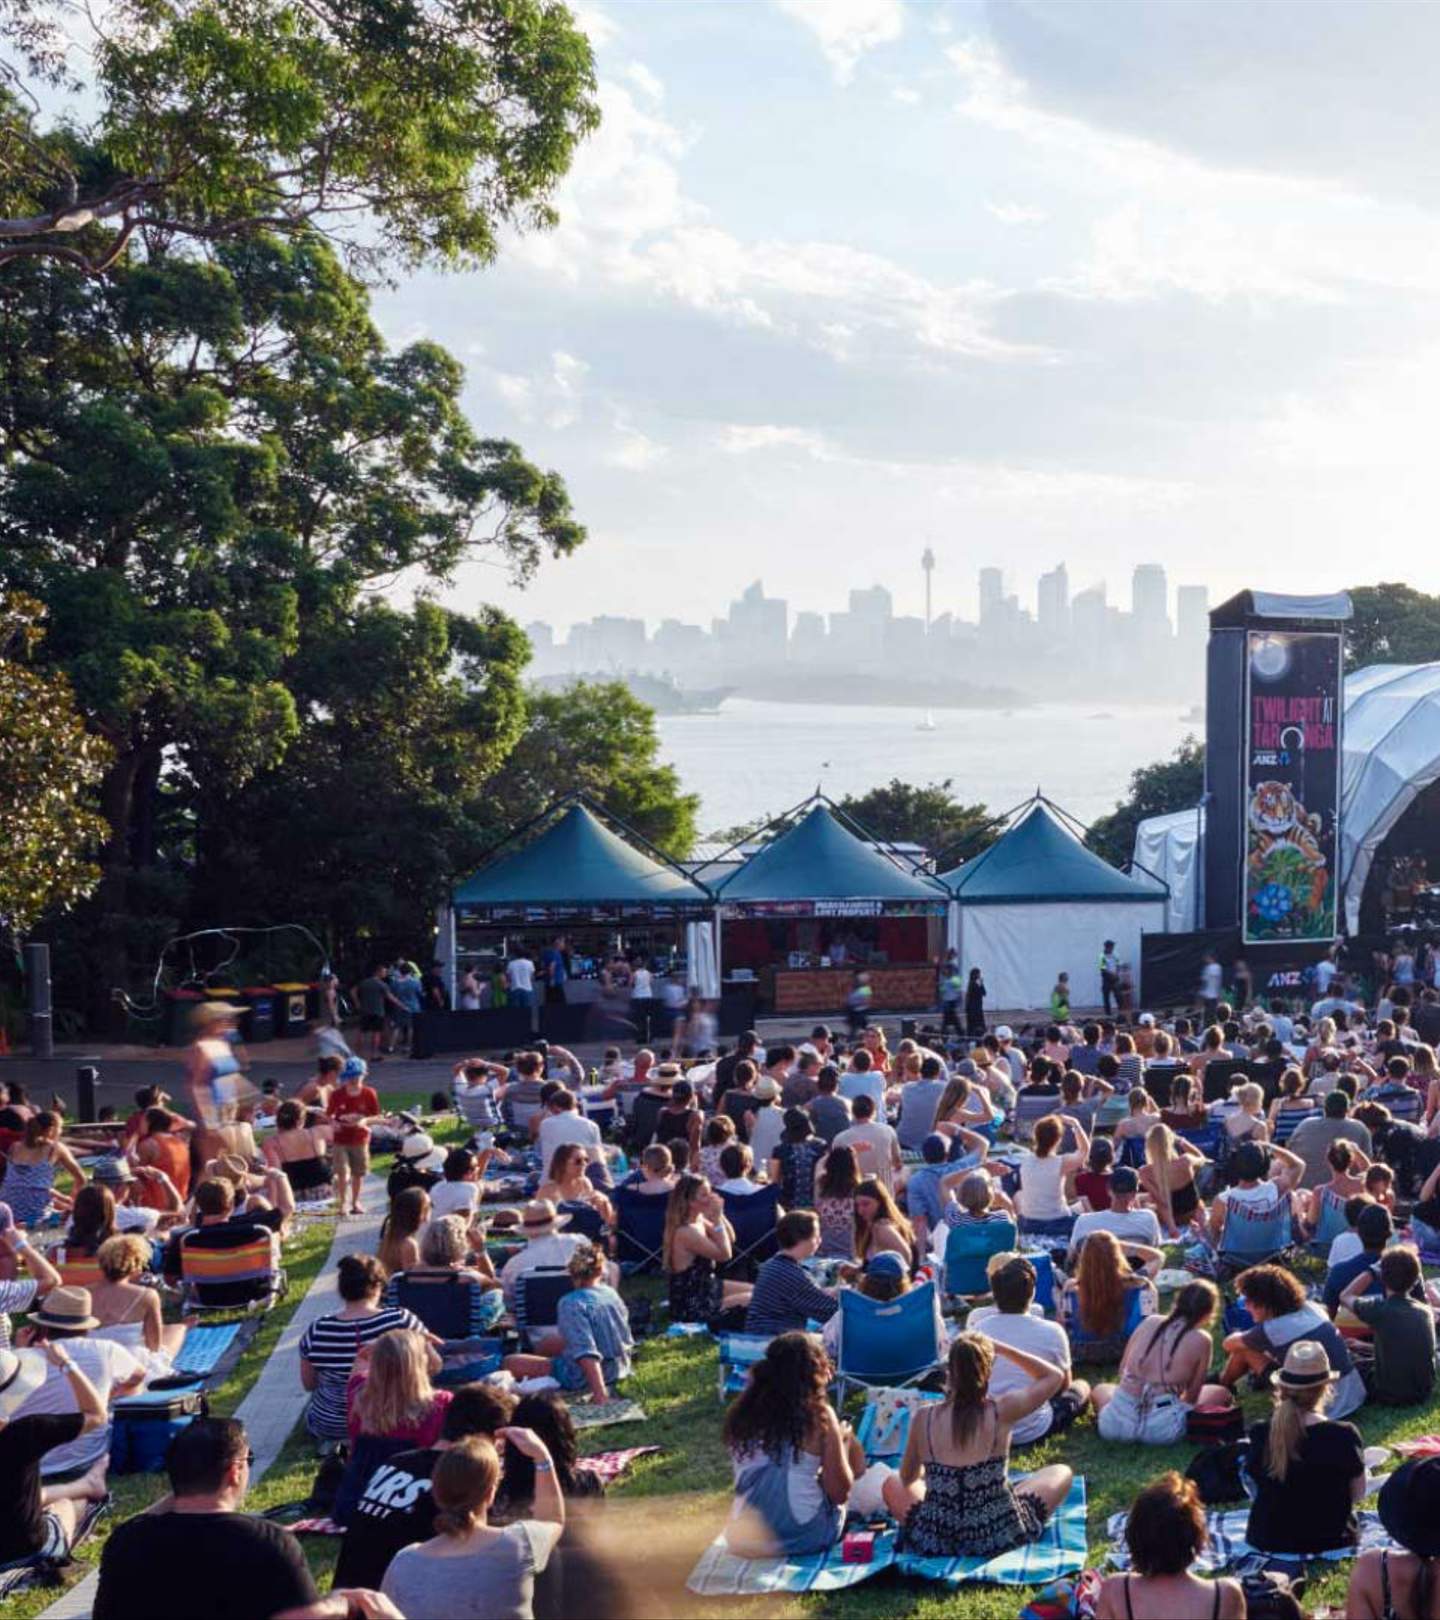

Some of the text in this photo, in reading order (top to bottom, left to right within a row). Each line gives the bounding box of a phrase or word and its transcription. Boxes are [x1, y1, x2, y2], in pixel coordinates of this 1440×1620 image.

[1253, 696, 1321, 721] TWILIGHT
[1253, 754, 1278, 765] ANZ
[1267, 970, 1302, 987] ANZ
